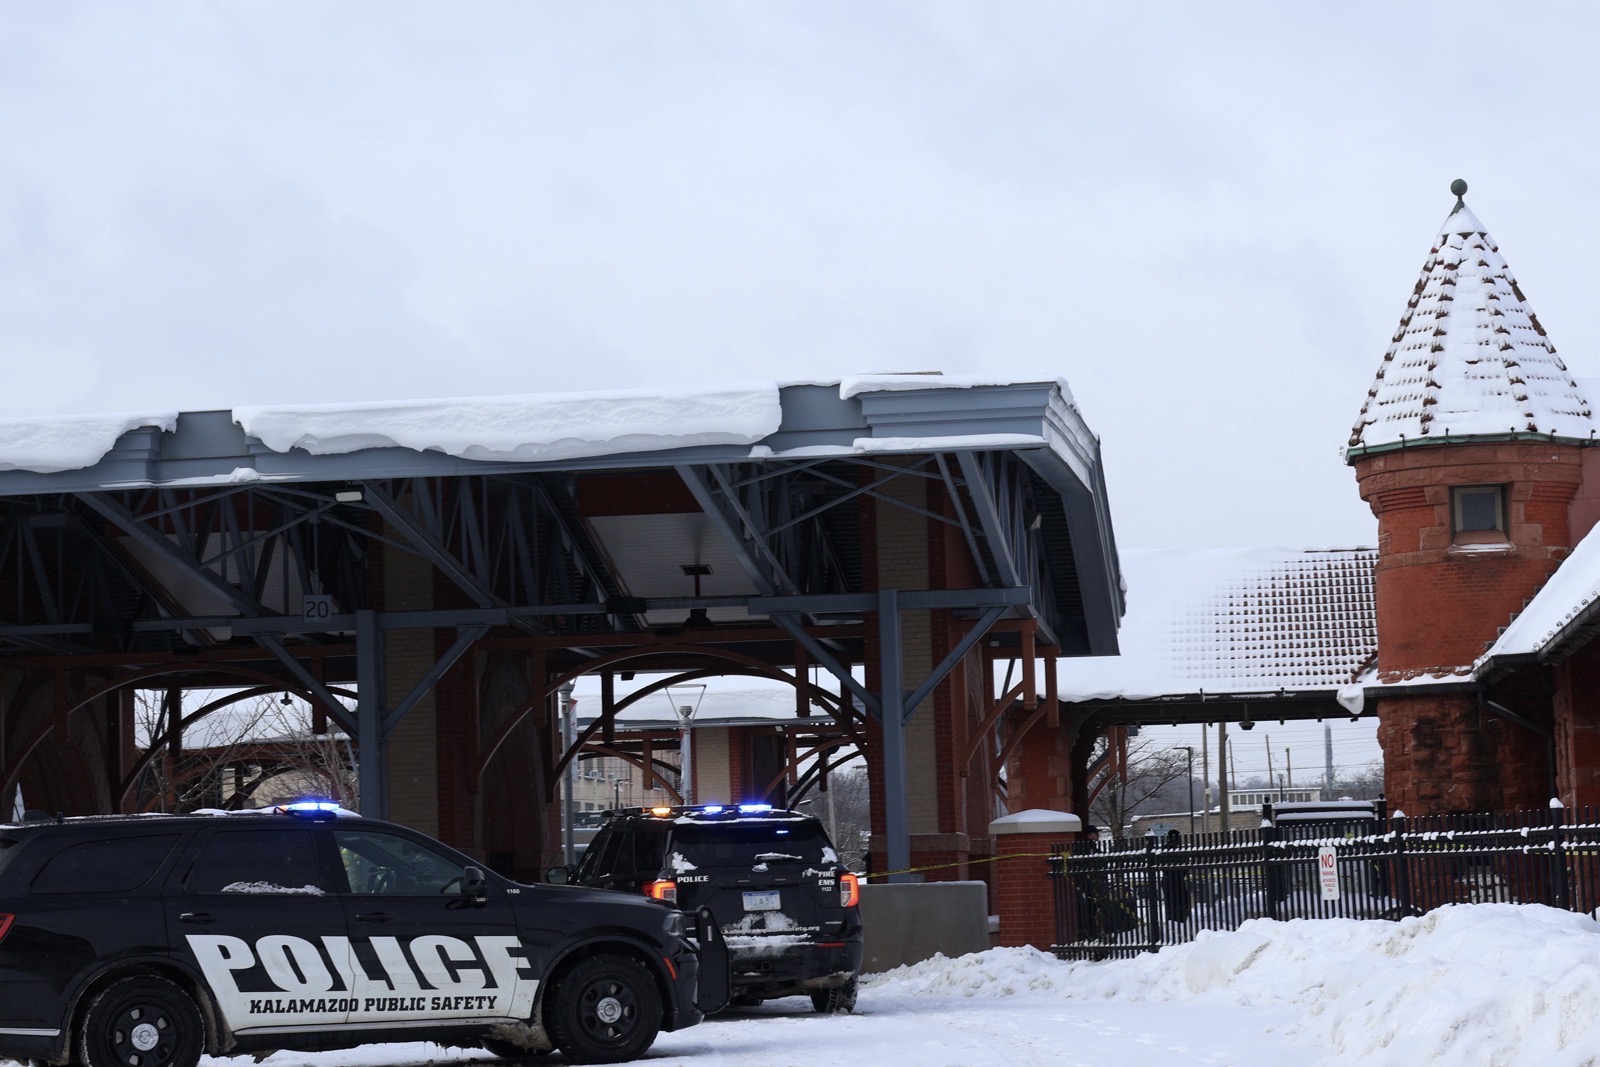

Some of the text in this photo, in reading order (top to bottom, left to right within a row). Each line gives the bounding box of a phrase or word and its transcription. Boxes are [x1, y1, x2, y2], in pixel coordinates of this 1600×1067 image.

[306, 600, 328, 618] 20
[1321, 854, 1334, 868] NO
[677, 875, 709, 883] POLICE
[185, 934, 539, 995] POLICE
[250, 995, 498, 1014] KALAMAZOO PUBLIC SAFETY
